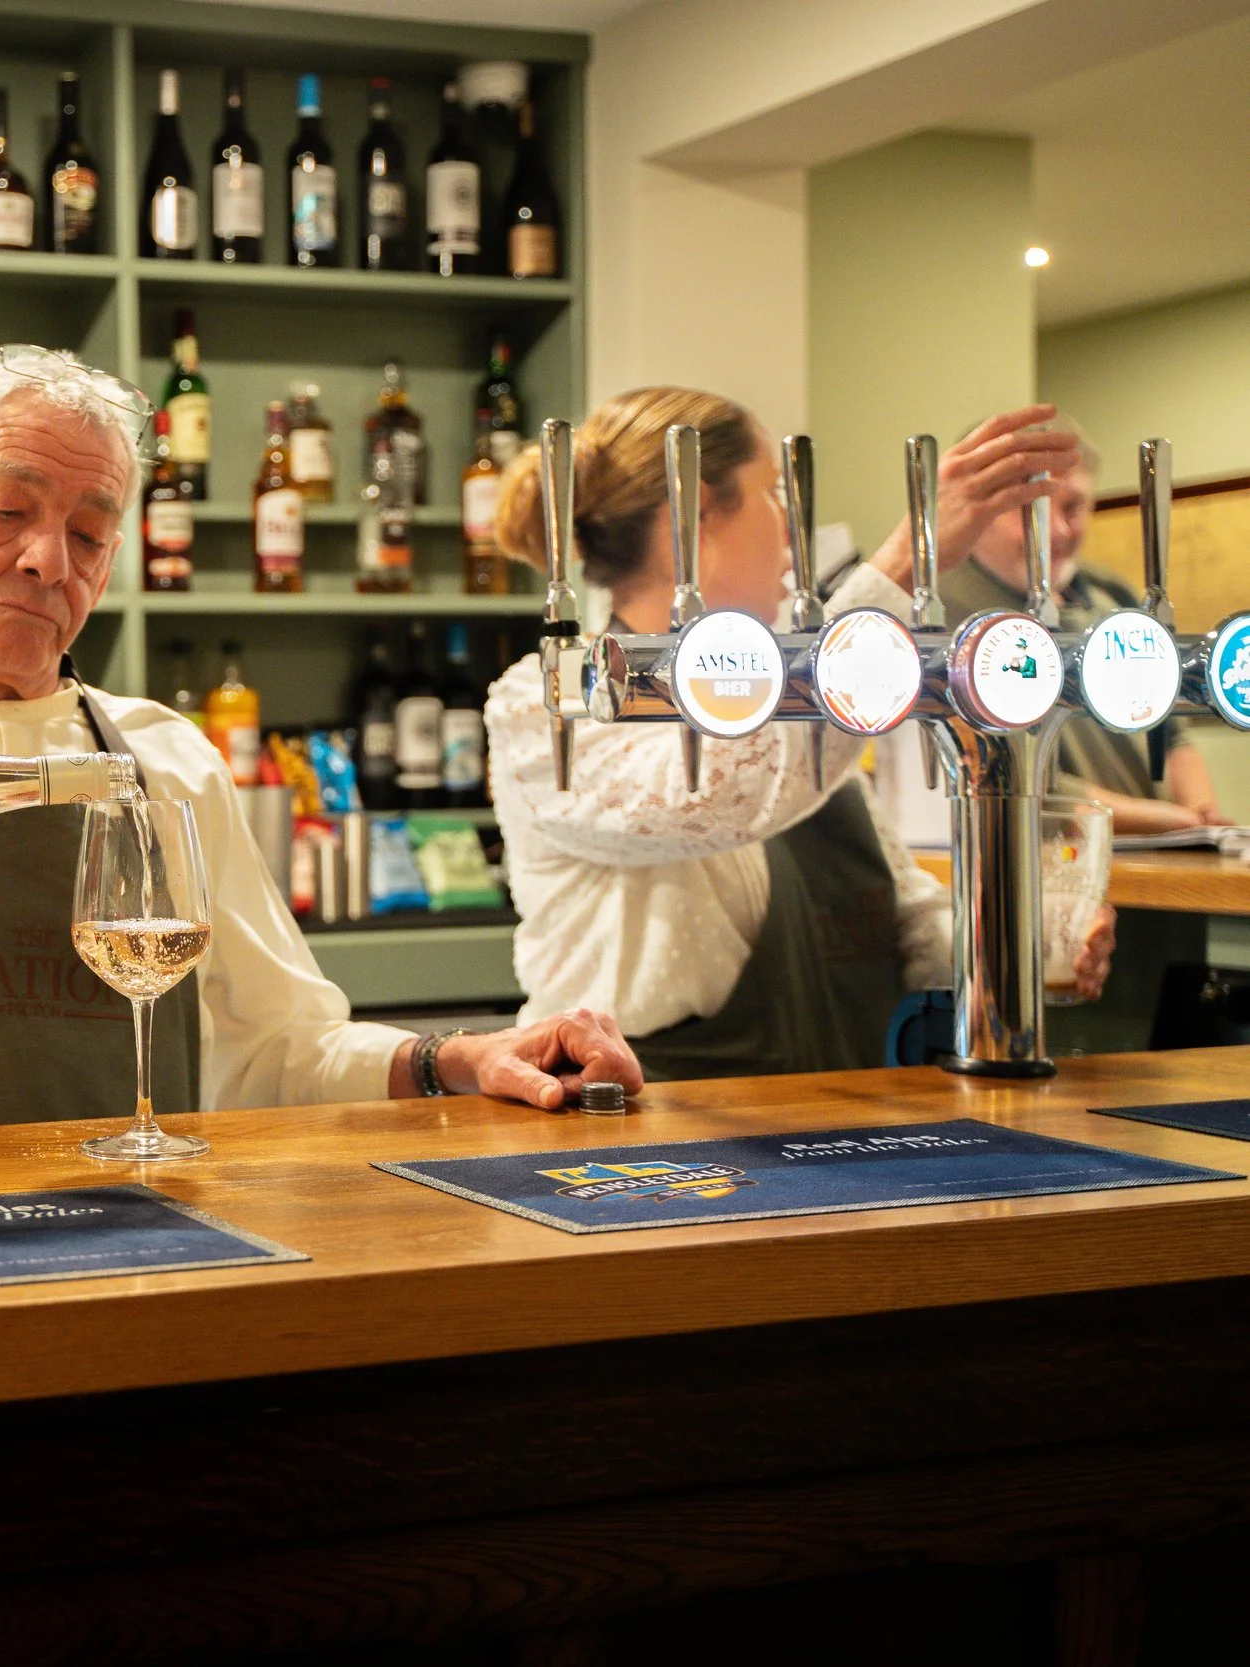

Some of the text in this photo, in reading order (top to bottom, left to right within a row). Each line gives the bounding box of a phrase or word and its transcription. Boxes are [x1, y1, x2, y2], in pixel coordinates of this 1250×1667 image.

[695, 652, 770, 672] AMSTEL
[783, 1135, 940, 1151] Real Ales
[781, 1147, 853, 1160] from
[569, 1166, 734, 1199] WENSLEYDALE
